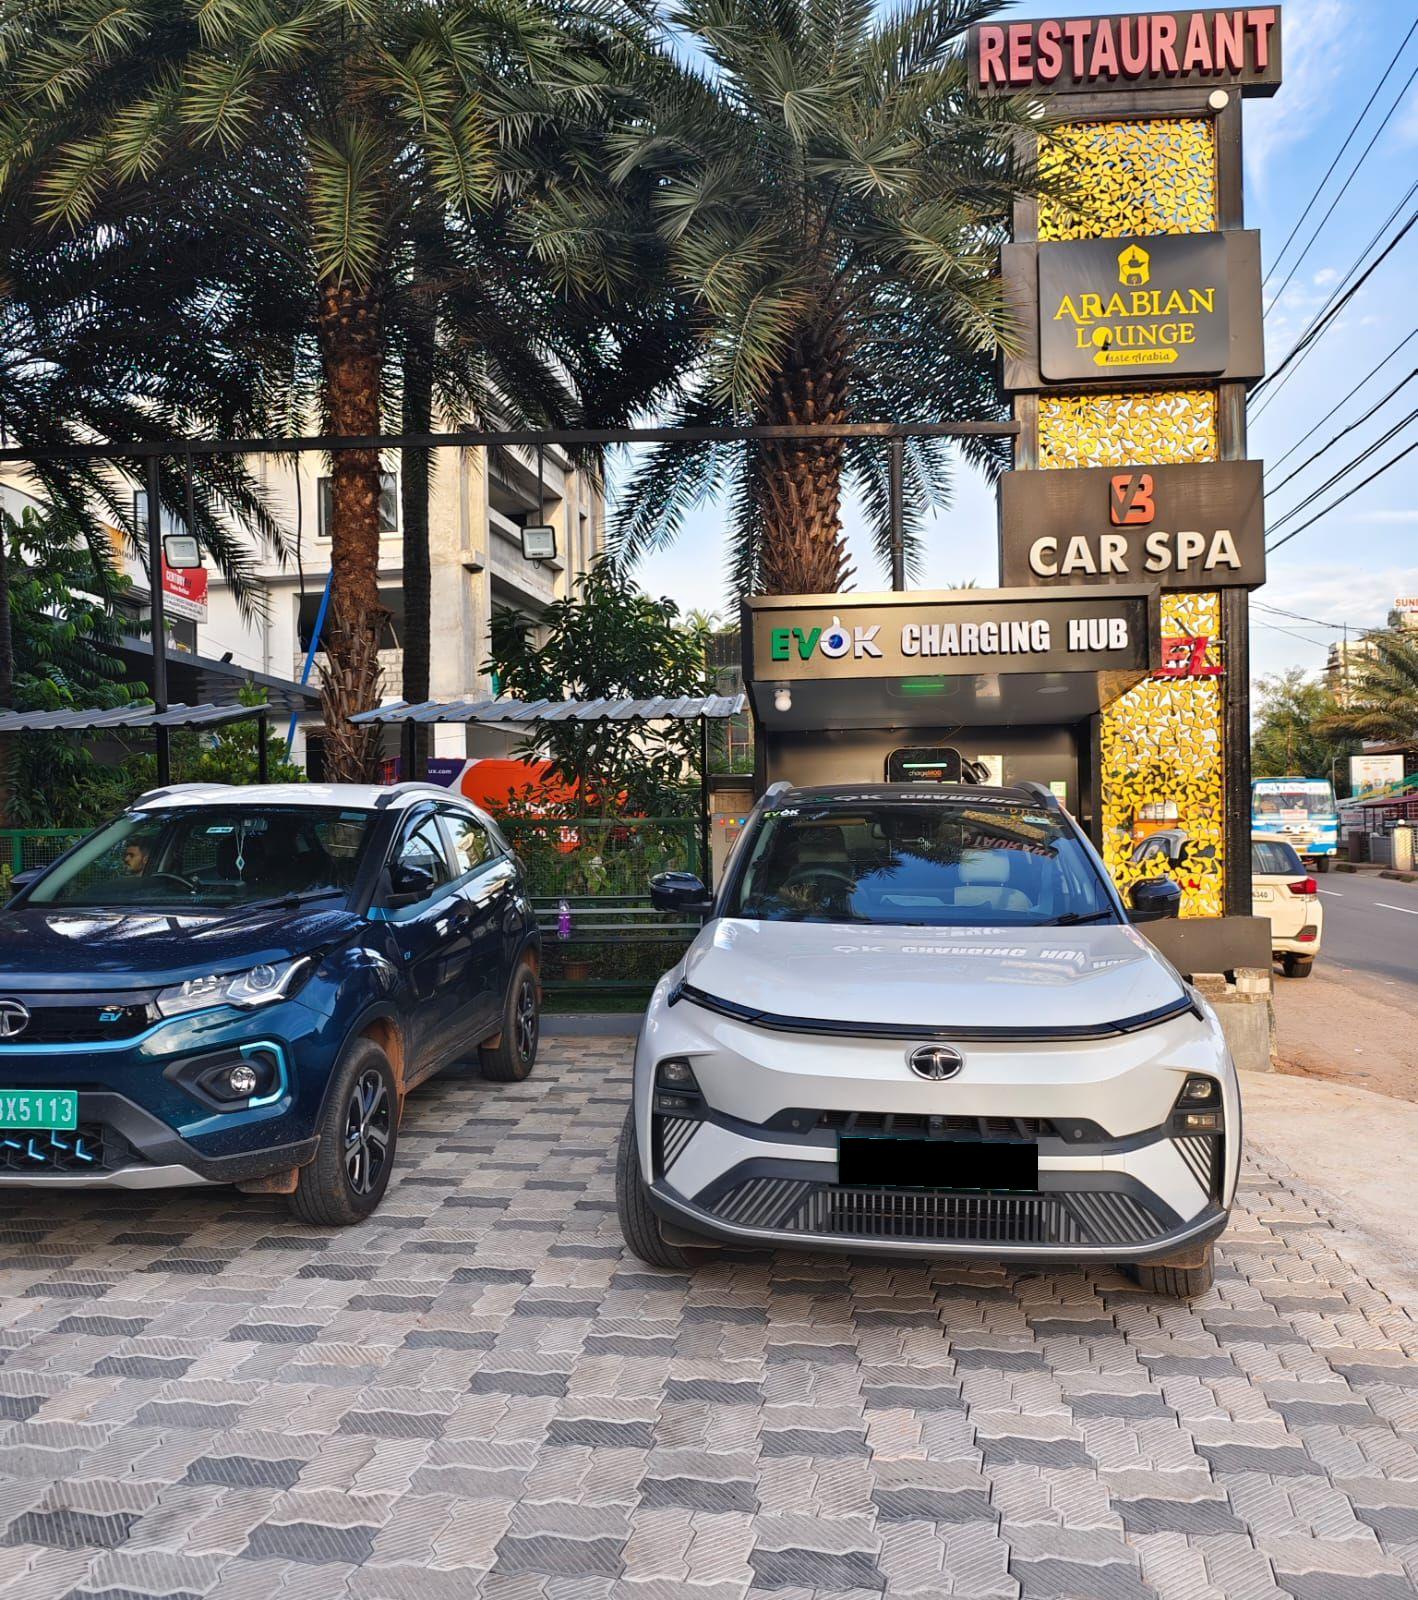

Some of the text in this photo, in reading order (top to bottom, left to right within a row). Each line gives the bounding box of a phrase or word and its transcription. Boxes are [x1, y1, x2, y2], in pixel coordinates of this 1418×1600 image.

[979, 9, 1275, 85] RESTAURANT
[1053, 288, 1215, 325] ARABIAN
[1075, 323, 1196, 350] LOUNGE
[1029, 530, 1242, 578] CAR SPA
[771, 616, 1128, 660] EVOK CHARGING HUB
[763, 809, 800, 818] EVOK
[99, 1012, 122, 1021] EV
